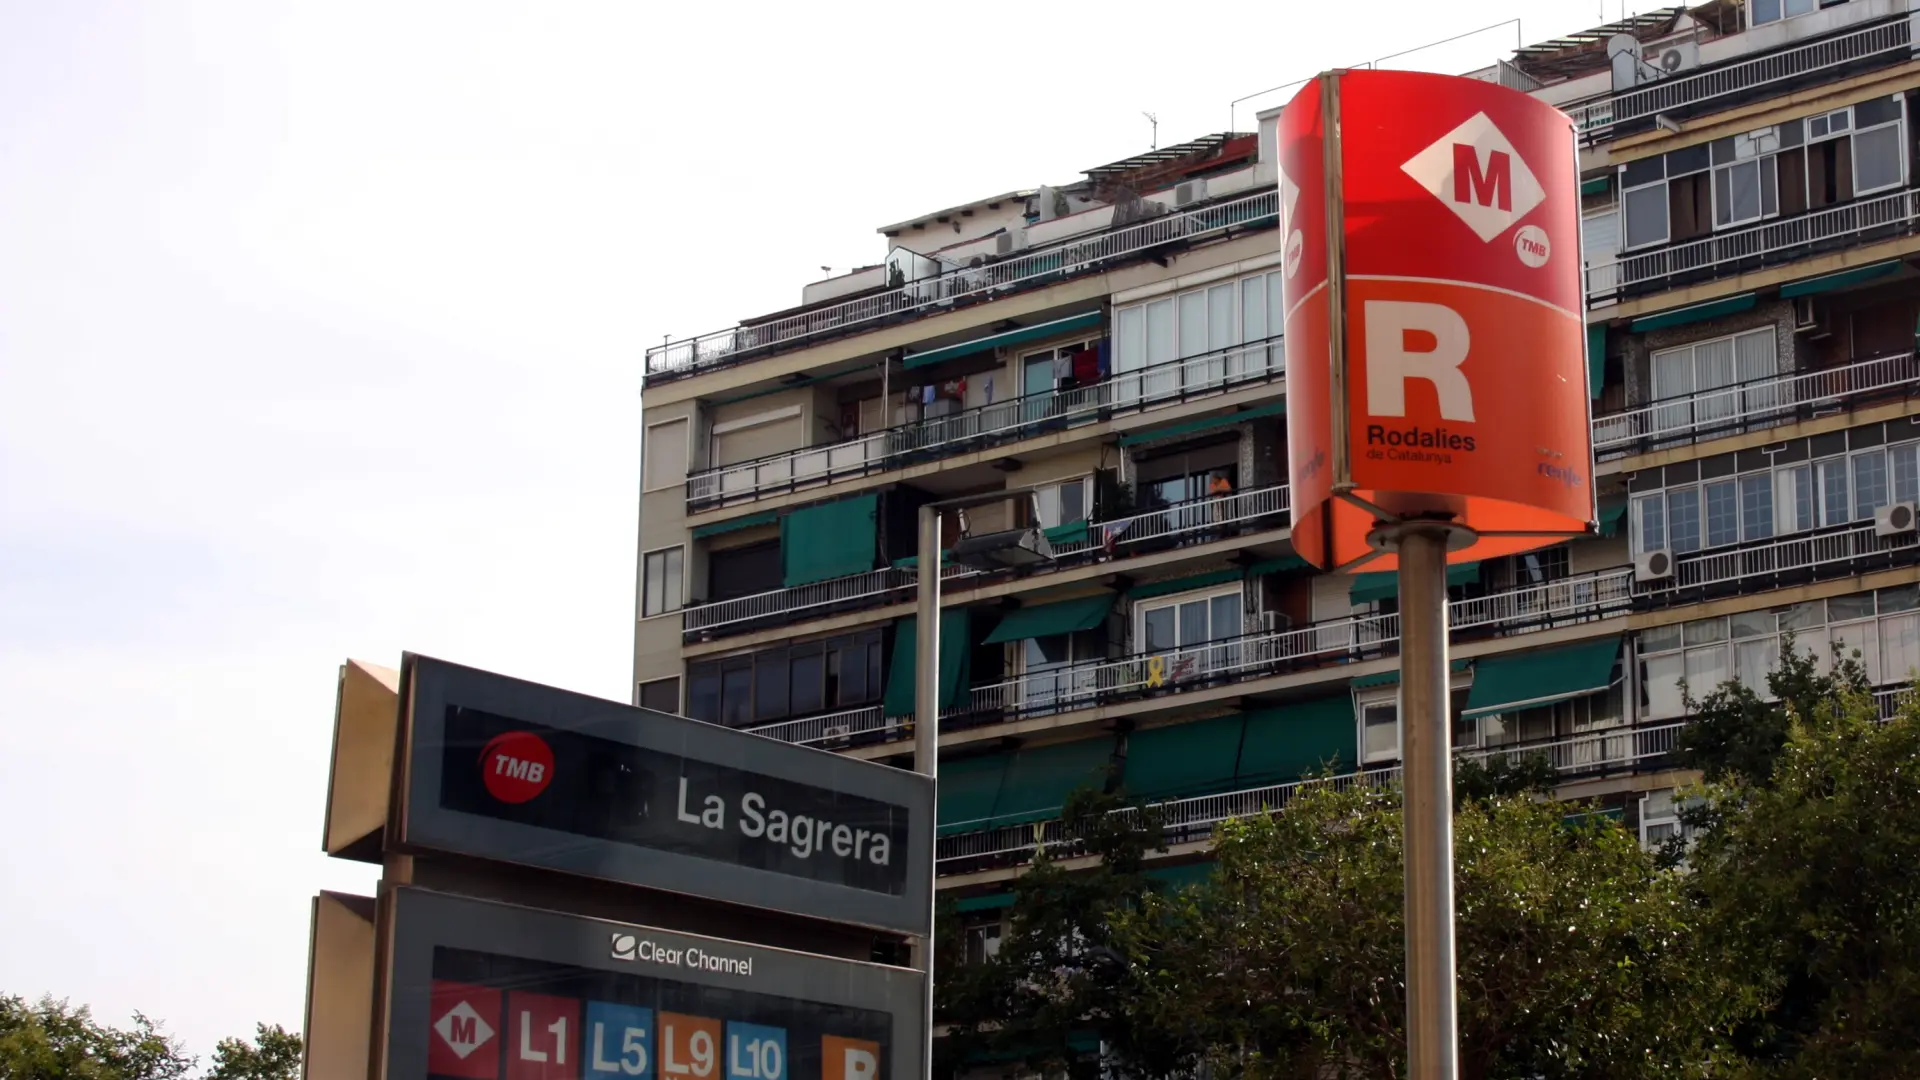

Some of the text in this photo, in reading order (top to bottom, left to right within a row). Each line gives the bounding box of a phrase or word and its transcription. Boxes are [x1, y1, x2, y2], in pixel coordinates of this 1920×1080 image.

[1453, 143, 1512, 213] M
[1522, 238, 1546, 257] TMB
[1364, 299, 1477, 423] R
[1366, 448, 1452, 465] de Catalunya
[1367, 425, 1476, 452] Rodalies
[495, 754, 545, 783] TMB
[677, 776, 890, 866] La Sagrera
[638, 940, 752, 976] Clear Channel
[450, 1015, 477, 1044] M
[520, 1010, 567, 1065] L1
[592, 1022, 648, 1076] L5
[664, 1026, 714, 1078] L9
[731, 1034, 782, 1080] L10
